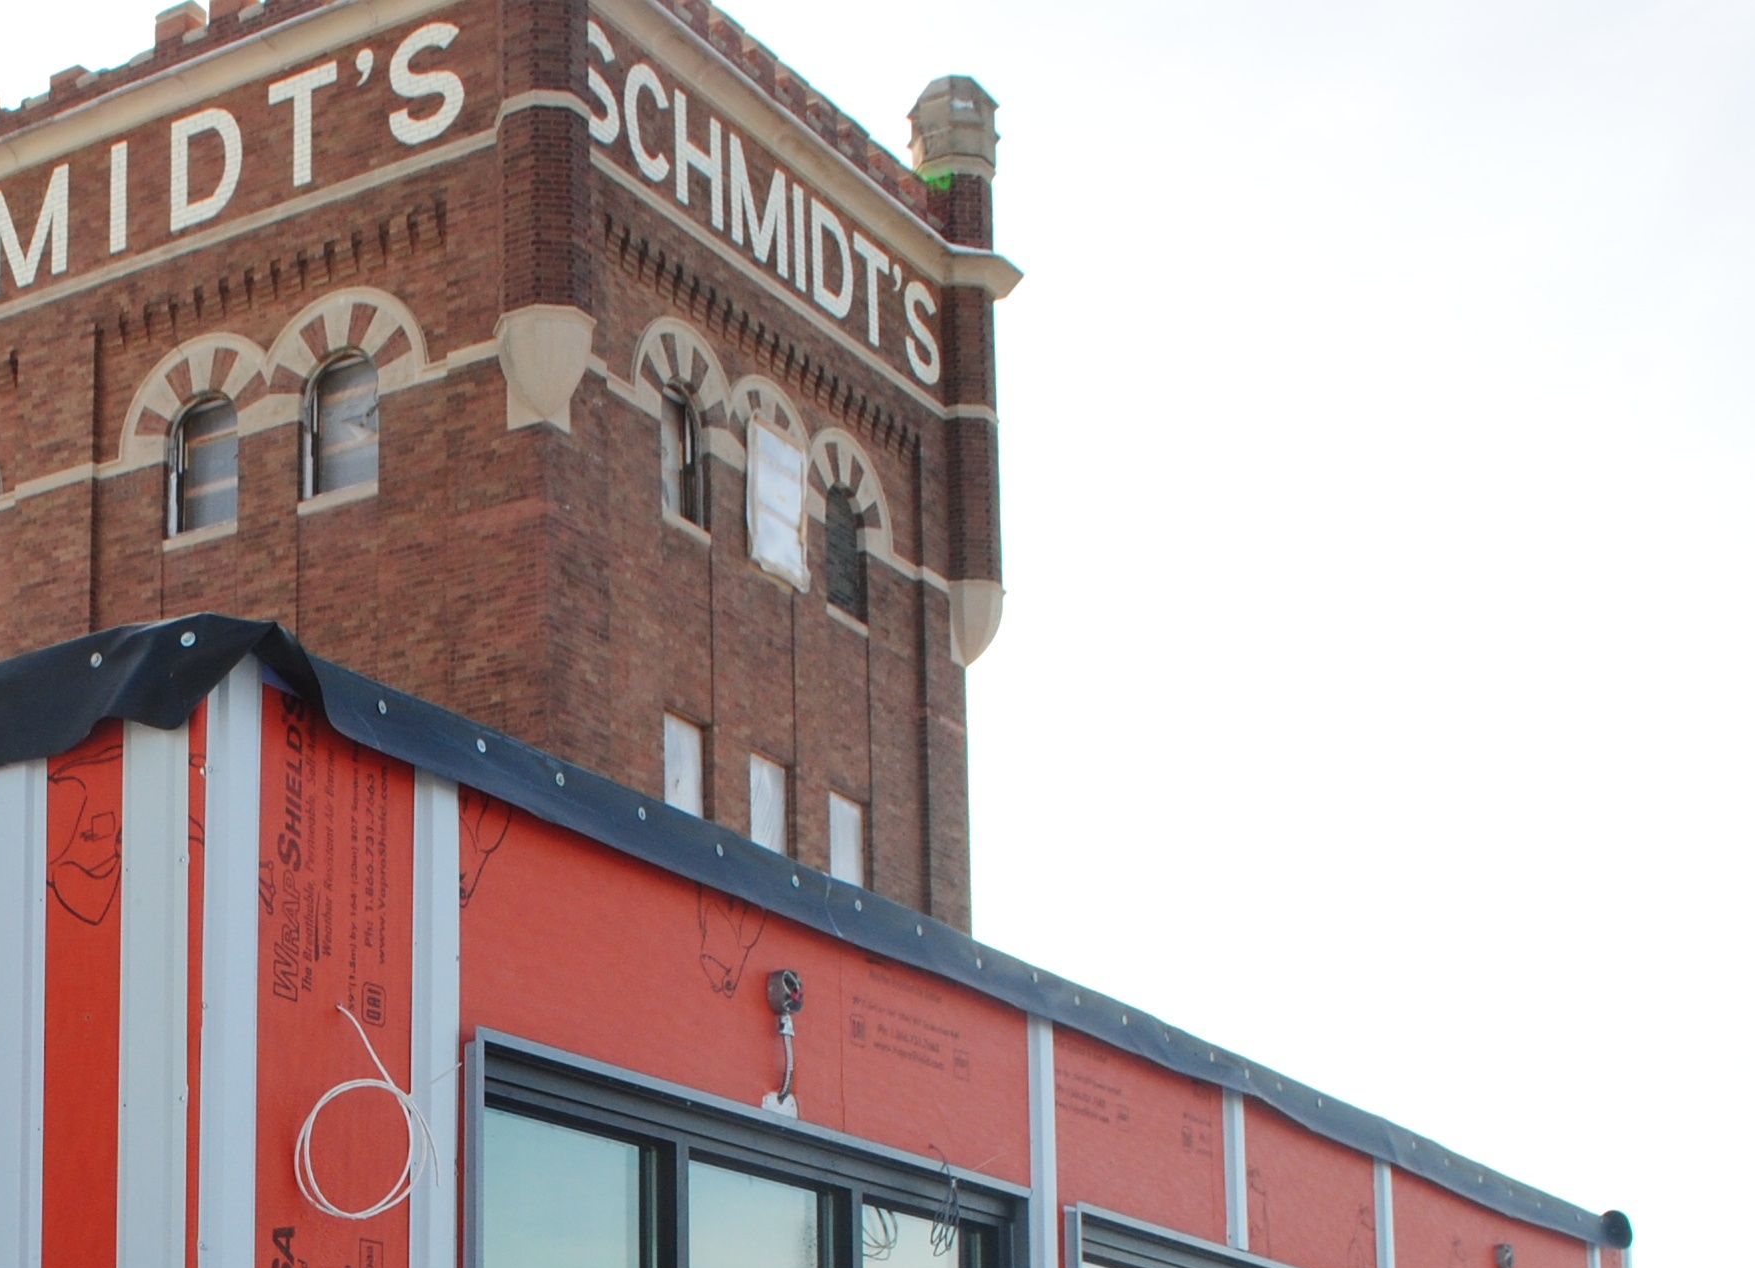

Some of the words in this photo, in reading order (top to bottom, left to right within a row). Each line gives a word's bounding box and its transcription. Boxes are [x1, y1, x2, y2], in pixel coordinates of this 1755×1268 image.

[587, 20, 941, 385] SCHMIDT'S
[323, 894, 333, 956] Weather
[365, 920, 374, 948] Ph:
[302, 966, 313, 992] The
